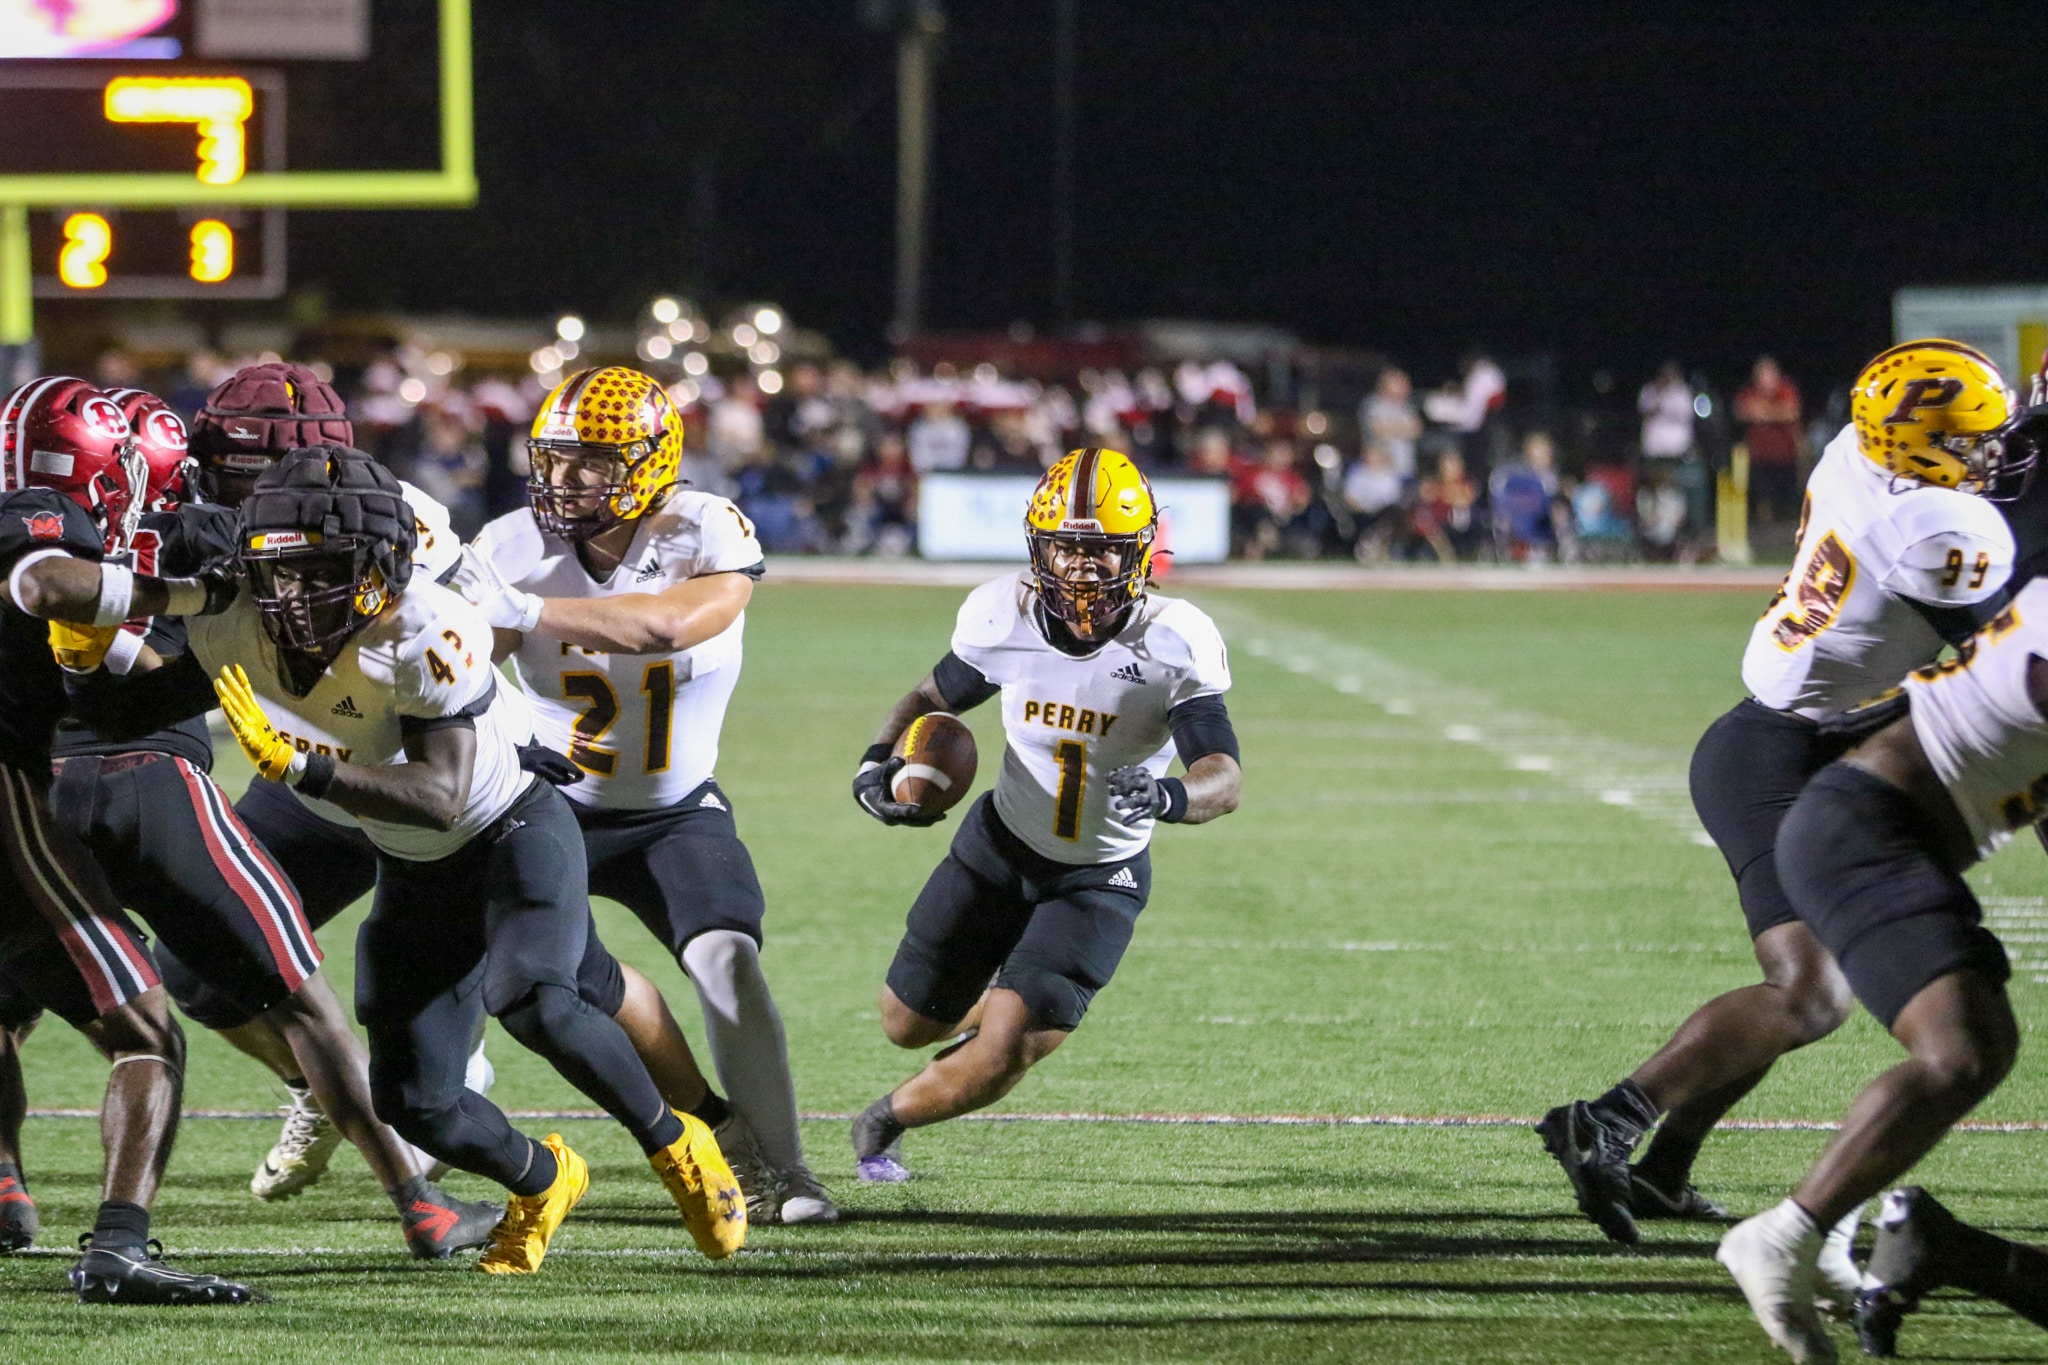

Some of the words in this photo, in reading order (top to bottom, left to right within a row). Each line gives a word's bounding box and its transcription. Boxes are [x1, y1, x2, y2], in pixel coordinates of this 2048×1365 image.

[1881, 377, 1966, 426] P
[267, 532, 302, 545] Riddell
[1063, 521, 1096, 530] Riddell
[1939, 548, 1990, 590] 99
[1110, 671, 1146, 685] adidas
[331, 706, 364, 719] adidas
[560, 659, 676, 779] 21
[1024, 699, 1119, 737] PERRY
[1052, 738, 1088, 843] 1
[1108, 877, 1138, 889] adidas
